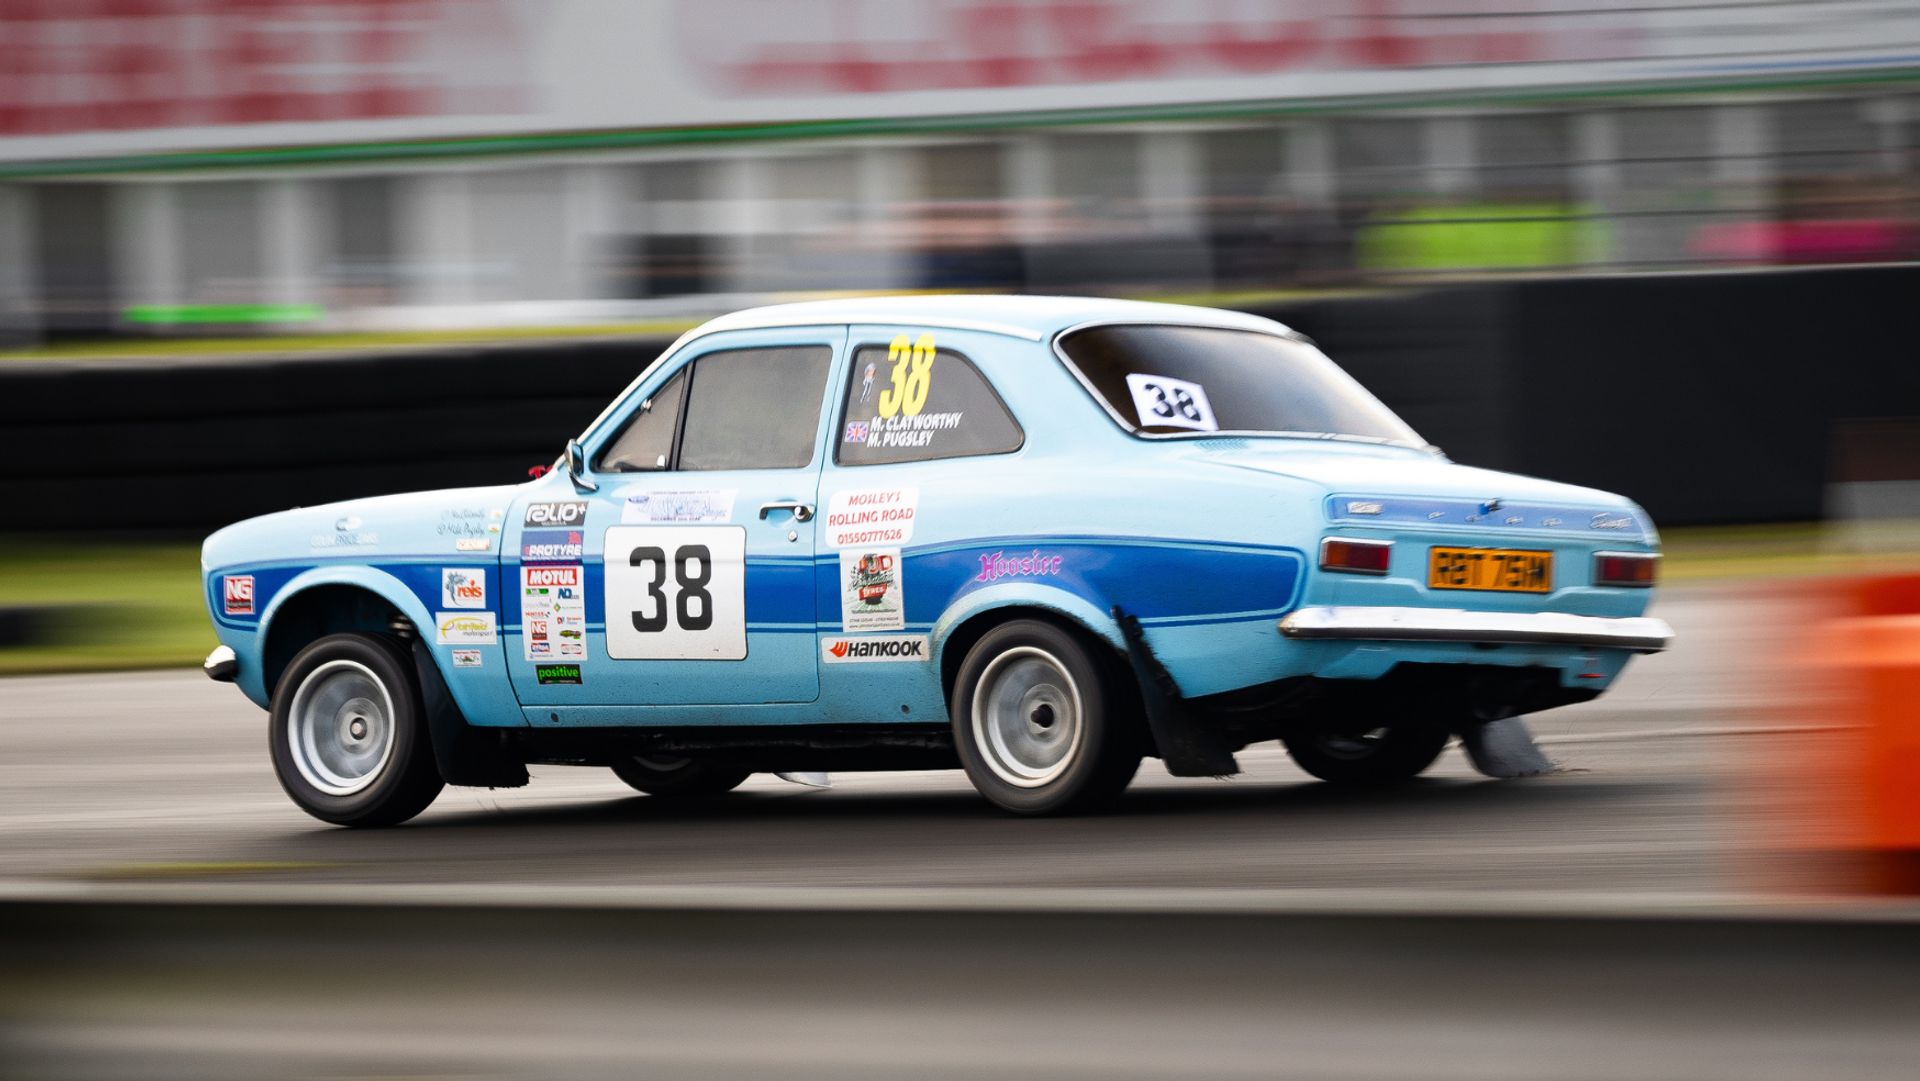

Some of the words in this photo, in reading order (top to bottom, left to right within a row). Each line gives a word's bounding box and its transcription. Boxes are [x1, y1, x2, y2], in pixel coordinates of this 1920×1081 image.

[878, 334, 937, 419] 38
[1144, 383, 1202, 422] 38
[870, 417, 884, 432] M.
[886, 412, 963, 431] CLATWORTHY
[867, 432, 881, 448] M.
[882, 430, 934, 447] PUGSLEY
[848, 491, 901, 506] MOSLEY'S
[829, 511, 878, 526] ROLLING
[881, 508, 914, 521] ROAD
[837, 529, 903, 545] 01550777626
[529, 544, 582, 557] PROTYRE
[975, 549, 1065, 582] Hoosier
[529, 570, 576, 585] MOTUL
[226, 579, 252, 600] NG
[457, 580, 483, 598] reis
[630, 545, 713, 632] 38
[538, 666, 579, 681] positive
